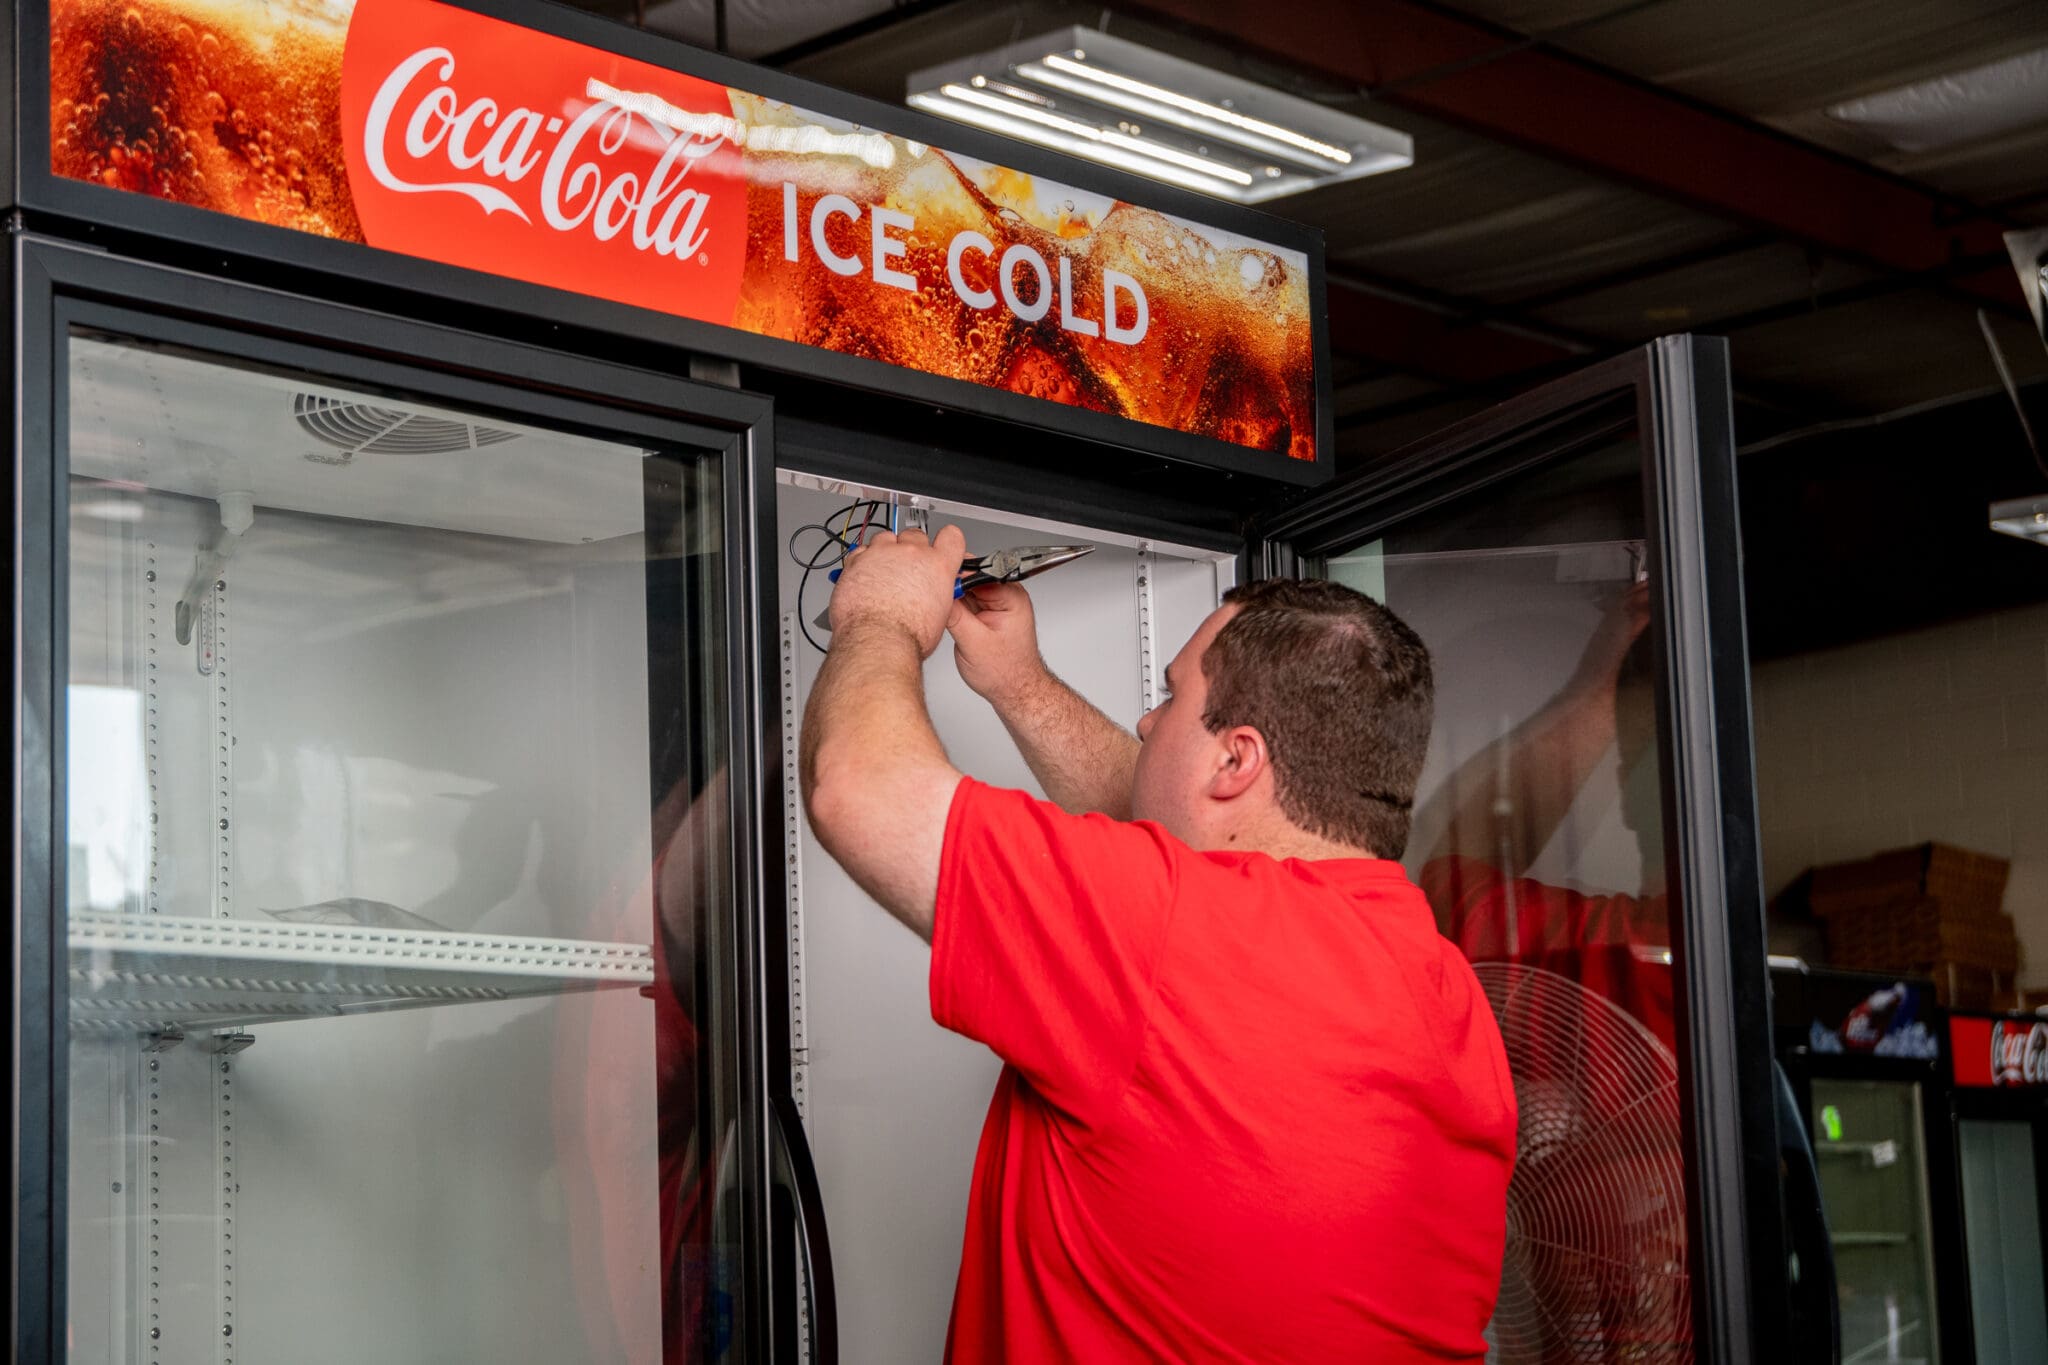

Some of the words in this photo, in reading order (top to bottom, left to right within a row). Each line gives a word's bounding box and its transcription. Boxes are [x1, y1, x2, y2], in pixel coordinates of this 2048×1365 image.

[364, 47, 723, 261] Coca-Cola
[783, 181, 919, 292] ICE
[946, 230, 1149, 346] COLD
